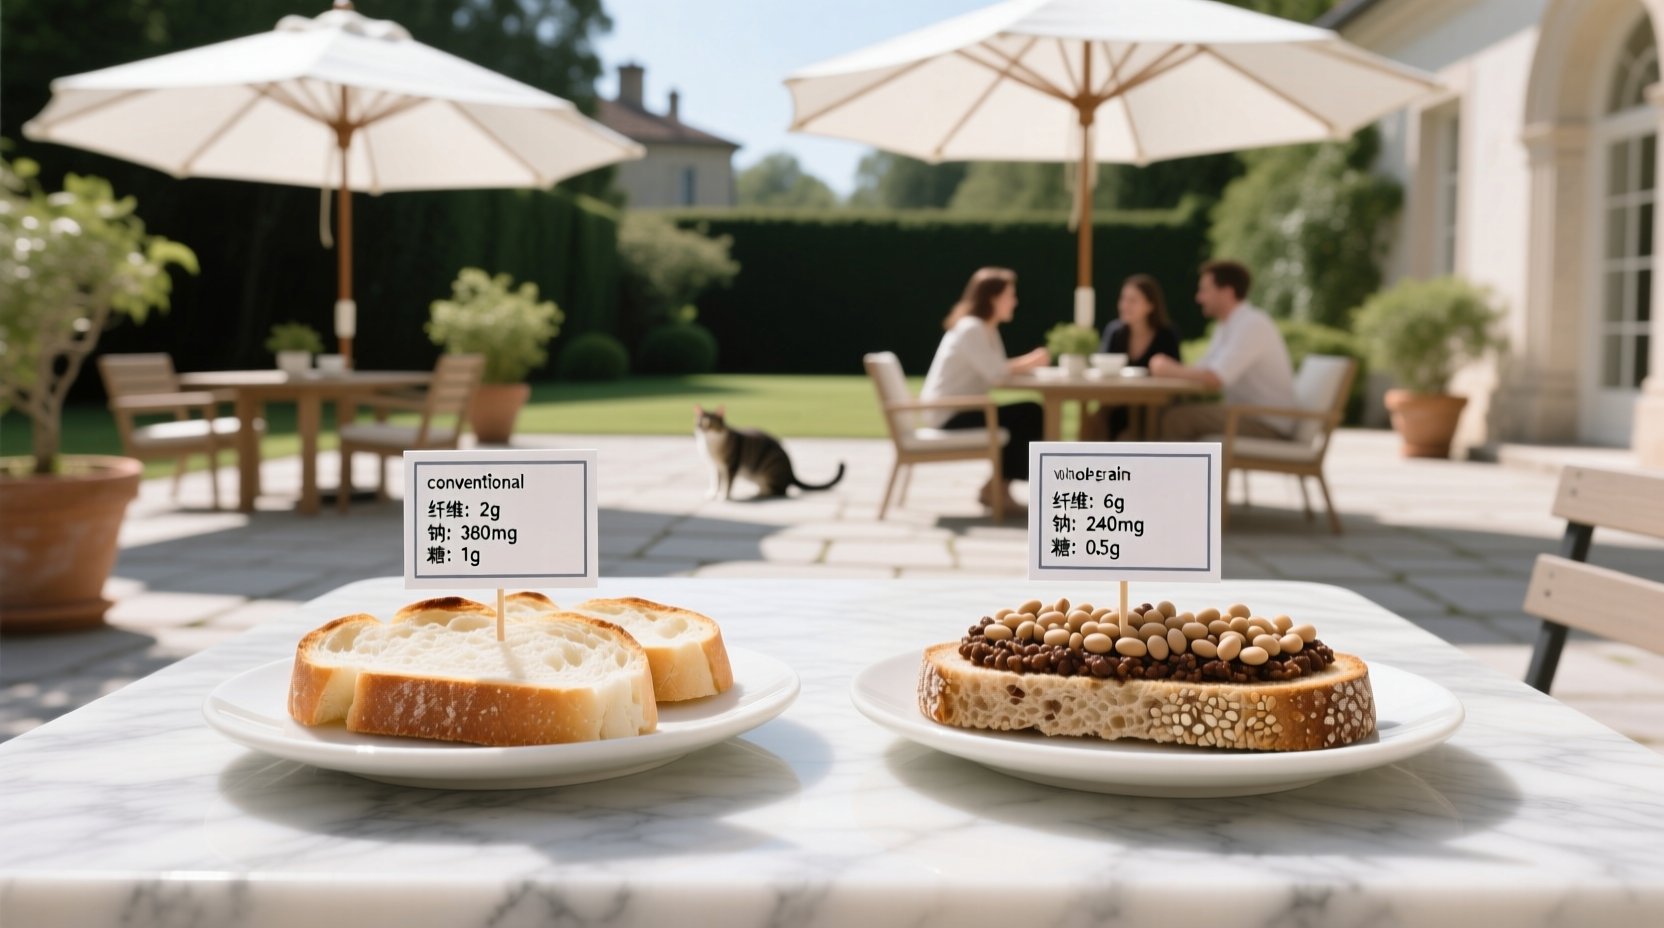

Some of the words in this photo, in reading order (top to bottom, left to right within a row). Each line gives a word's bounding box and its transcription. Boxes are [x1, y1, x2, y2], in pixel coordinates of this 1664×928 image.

[427, 472, 525, 490] conventional
[479, 501, 501, 522] 2g
[1103, 493, 1125, 514] 6g
[1085, 515, 1145, 538] 240mg
[461, 546, 480, 567] 1g
[1085, 538, 1120, 561] 0.5g
